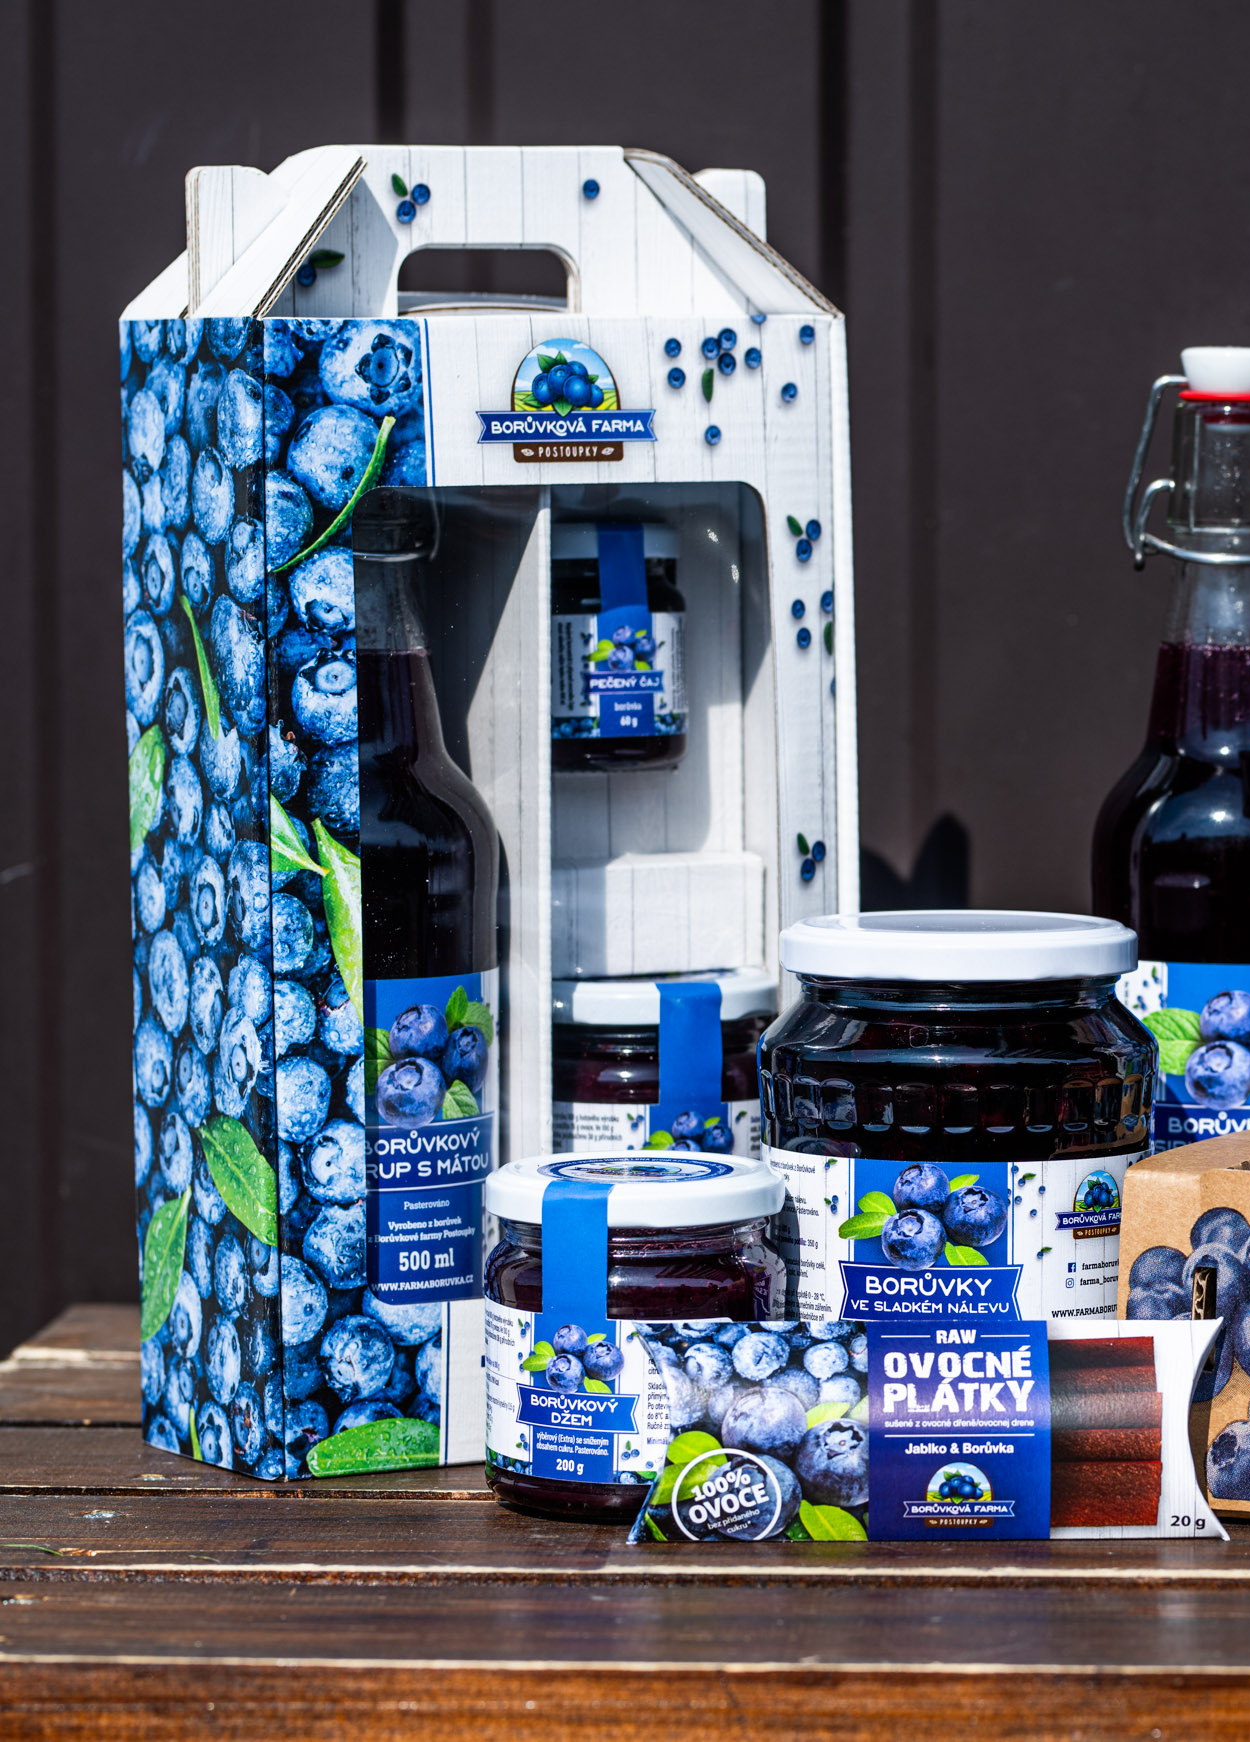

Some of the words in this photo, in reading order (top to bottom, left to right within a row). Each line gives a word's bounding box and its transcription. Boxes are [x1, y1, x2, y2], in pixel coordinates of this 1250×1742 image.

[491, 416, 587, 437] BORŮVKOVÁ
[592, 420, 645, 433] FARMA
[538, 446, 598, 458] POSTOUPKY
[589, 676, 638, 689] PEČENÝ
[639, 677, 660, 688] ČAJ
[366, 1162, 411, 1179] RUP
[417, 1160, 432, 1177] S
[437, 1152, 489, 1175] MÁTOU
[404, 1199, 450, 1210] Pasterováno
[388, 1221, 427, 1231] Vyrobeno
[434, 1216, 462, 1227] borůvek
[1062, 1213, 1106, 1225] BORŮVKOVÁ
[1108, 1213, 1121, 1221] FAR
[374, 1231, 418, 1243] Borůvkové
[420, 1232, 442, 1243] farmy
[443, 1226, 476, 1239] Postoupky
[1085, 1228, 1111, 1236] POSTOUPKY
[399, 1250, 430, 1271] 500
[434, 1248, 455, 1269] ml
[1082, 1260, 1119, 1270] farmaboruv
[371, 1274, 474, 1292] WWW.FARMABORUVKA.CZ
[866, 1273, 993, 1297] BORŮVKY
[1080, 1275, 1118, 1286] farma_boruv
[851, 1300, 870, 1312] VE
[874, 1300, 943, 1313] SLADKÉM
[948, 1301, 1010, 1313] NÁLEVU
[1052, 1304, 1117, 1318] WWW.FARMABORU
[936, 1329, 977, 1344] RAW
[883, 1345, 1032, 1379] OVOCNÉ
[883, 1377, 1035, 1413] PLÁTKY
[530, 1394, 618, 1413] BORŮVKOVÝ
[551, 1410, 593, 1426] DŽEM
[885, 1419, 914, 1428] sušené
[922, 1419, 952, 1428] ovocné
[953, 1418, 1010, 1429] dřeně/ovocnej
[1011, 1418, 1035, 1427] drene
[536, 1431, 558, 1444] výběrový
[558, 1433, 575, 1445] (Extra)
[536, 1442, 557, 1451] obsahem
[905, 1443, 947, 1455] Jablko
[950, 1443, 960, 1455] &
[962, 1442, 1015, 1455] Borůvka
[556, 1458, 575, 1472] 200
[577, 1463, 584, 1475] g
[691, 1469, 751, 1502] 100%
[688, 1482, 770, 1524] OVOCE
[911, 1503, 971, 1515] BORŮVKOVÁ
[974, 1505, 1008, 1513] FARMA
[707, 1519, 722, 1530] bez
[722, 1508, 760, 1527] přidaného
[939, 1518, 978, 1526] POSTOUPKY
[1170, 1515, 1191, 1527] 20
[1195, 1518, 1206, 1530] g
